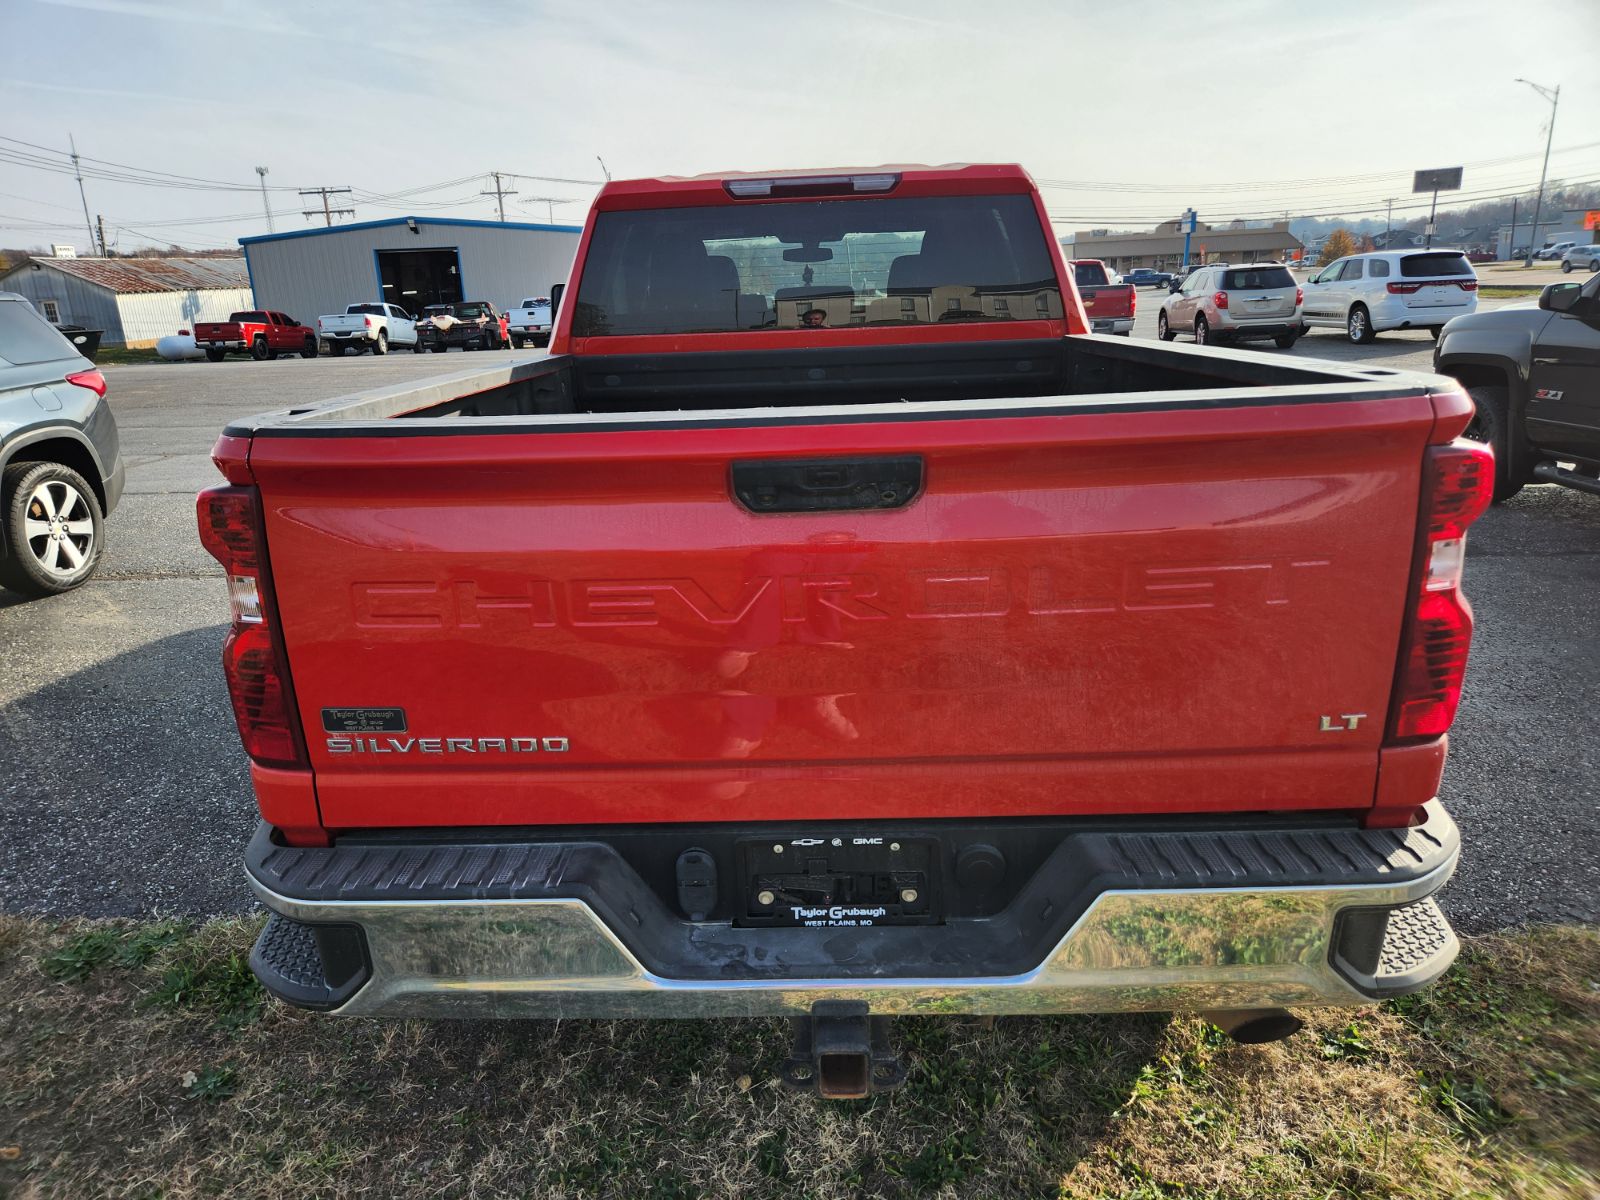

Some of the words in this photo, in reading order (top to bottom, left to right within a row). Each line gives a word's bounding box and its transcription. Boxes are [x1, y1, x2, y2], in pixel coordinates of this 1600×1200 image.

[349, 556, 1331, 629] CHEVROLET
[1320, 714, 1368, 730] LT
[326, 736, 570, 754] SILVERADO
[790, 907, 827, 920] Taylor
[829, 906, 886, 920] Grubaugh
